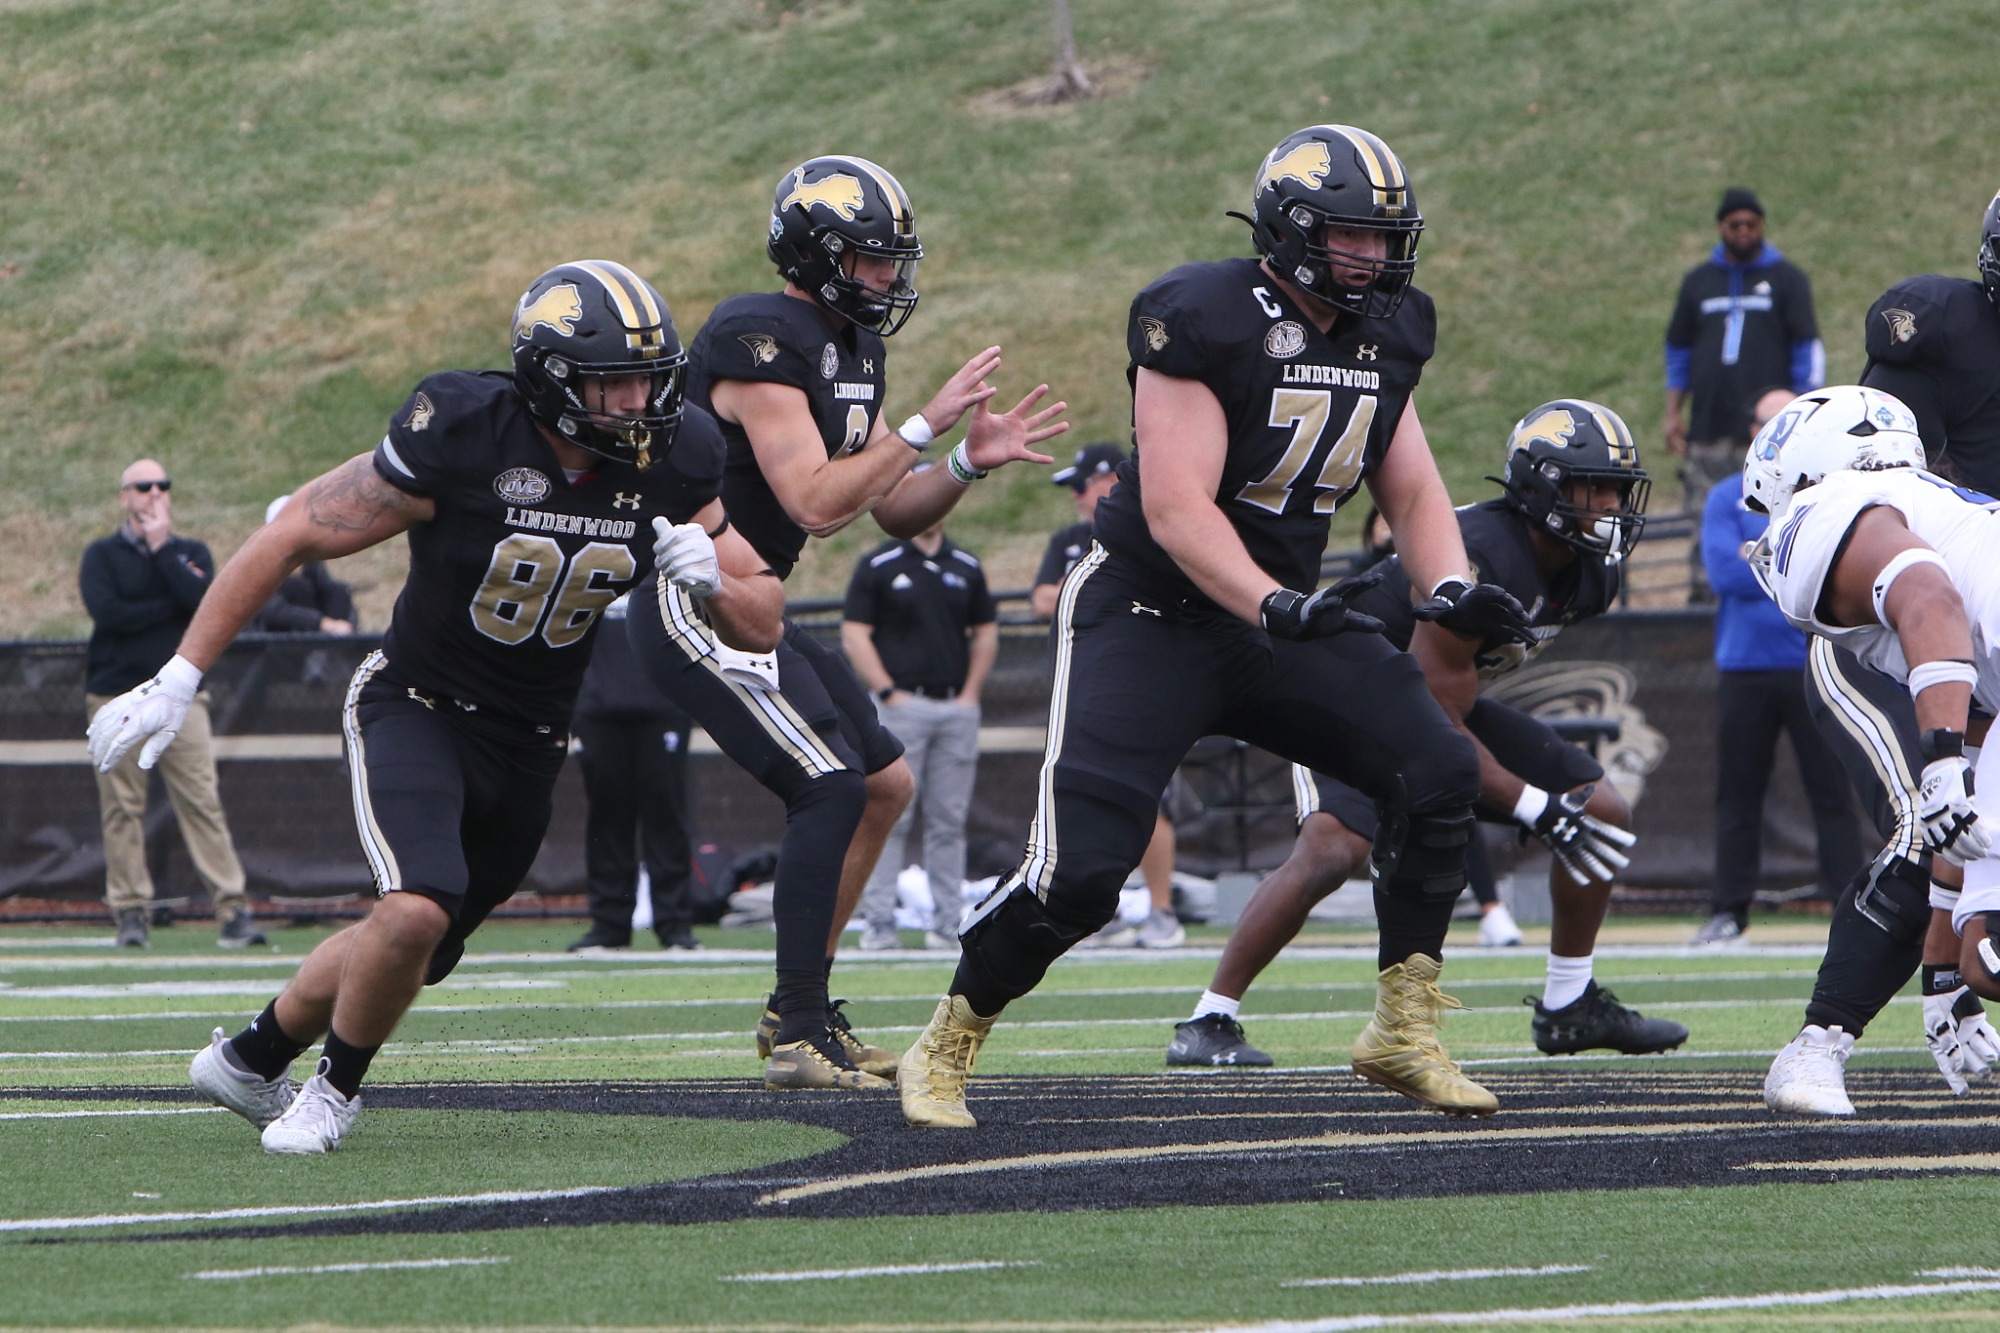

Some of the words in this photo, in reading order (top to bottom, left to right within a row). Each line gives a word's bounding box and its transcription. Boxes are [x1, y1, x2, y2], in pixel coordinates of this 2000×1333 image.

[653, 376, 673, 408] Riddell
[1282, 364, 1380, 390] LINDENWOOD
[1234, 387, 1378, 515] 74
[504, 479, 543, 495] OVC
[504, 506, 637, 539] LINDENWOOD
[469, 532, 637, 649] 86
